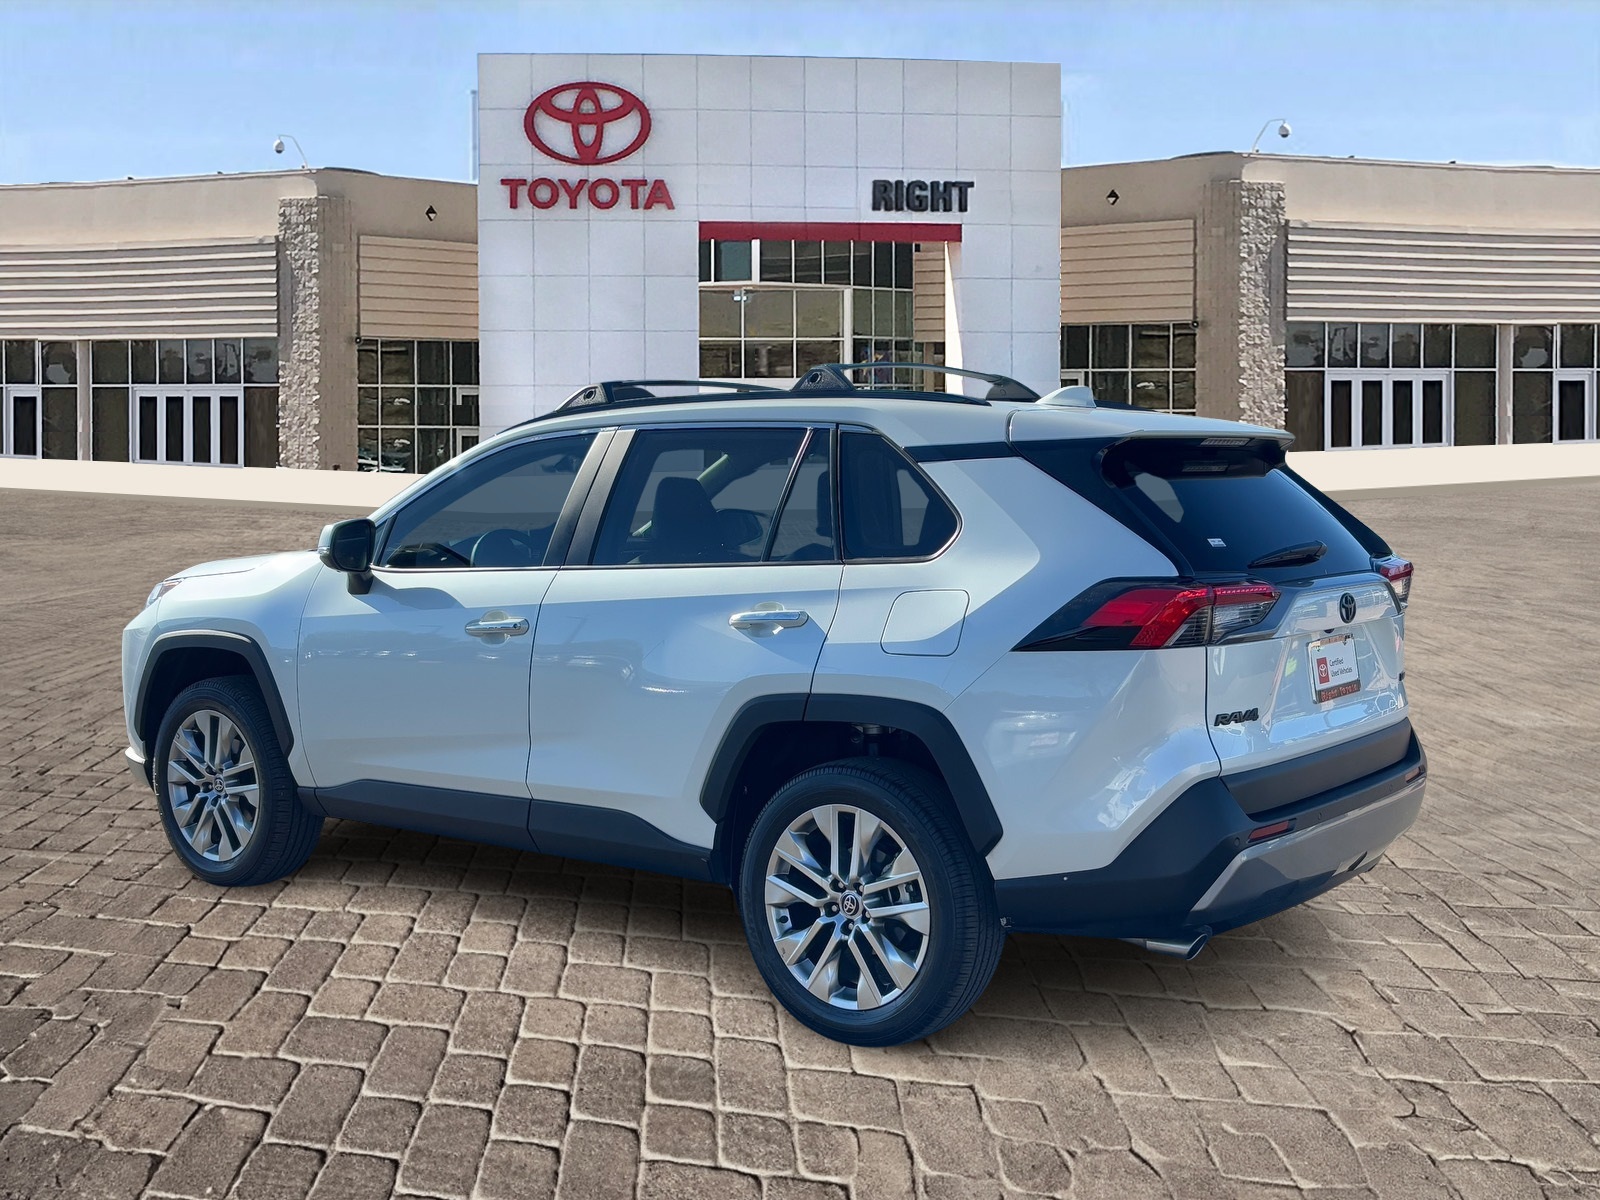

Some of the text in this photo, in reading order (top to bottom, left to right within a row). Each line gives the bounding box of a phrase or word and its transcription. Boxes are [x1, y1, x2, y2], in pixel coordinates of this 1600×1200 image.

[500, 178, 675, 209] TOYOTA
[872, 180, 975, 212] RIGHT
[1329, 657, 1344, 667] Certified
[1331, 666, 1353, 677] Used Vehicles
[1340, 683, 1357, 696] Toyota
[1214, 708, 1259, 726] RAV4
